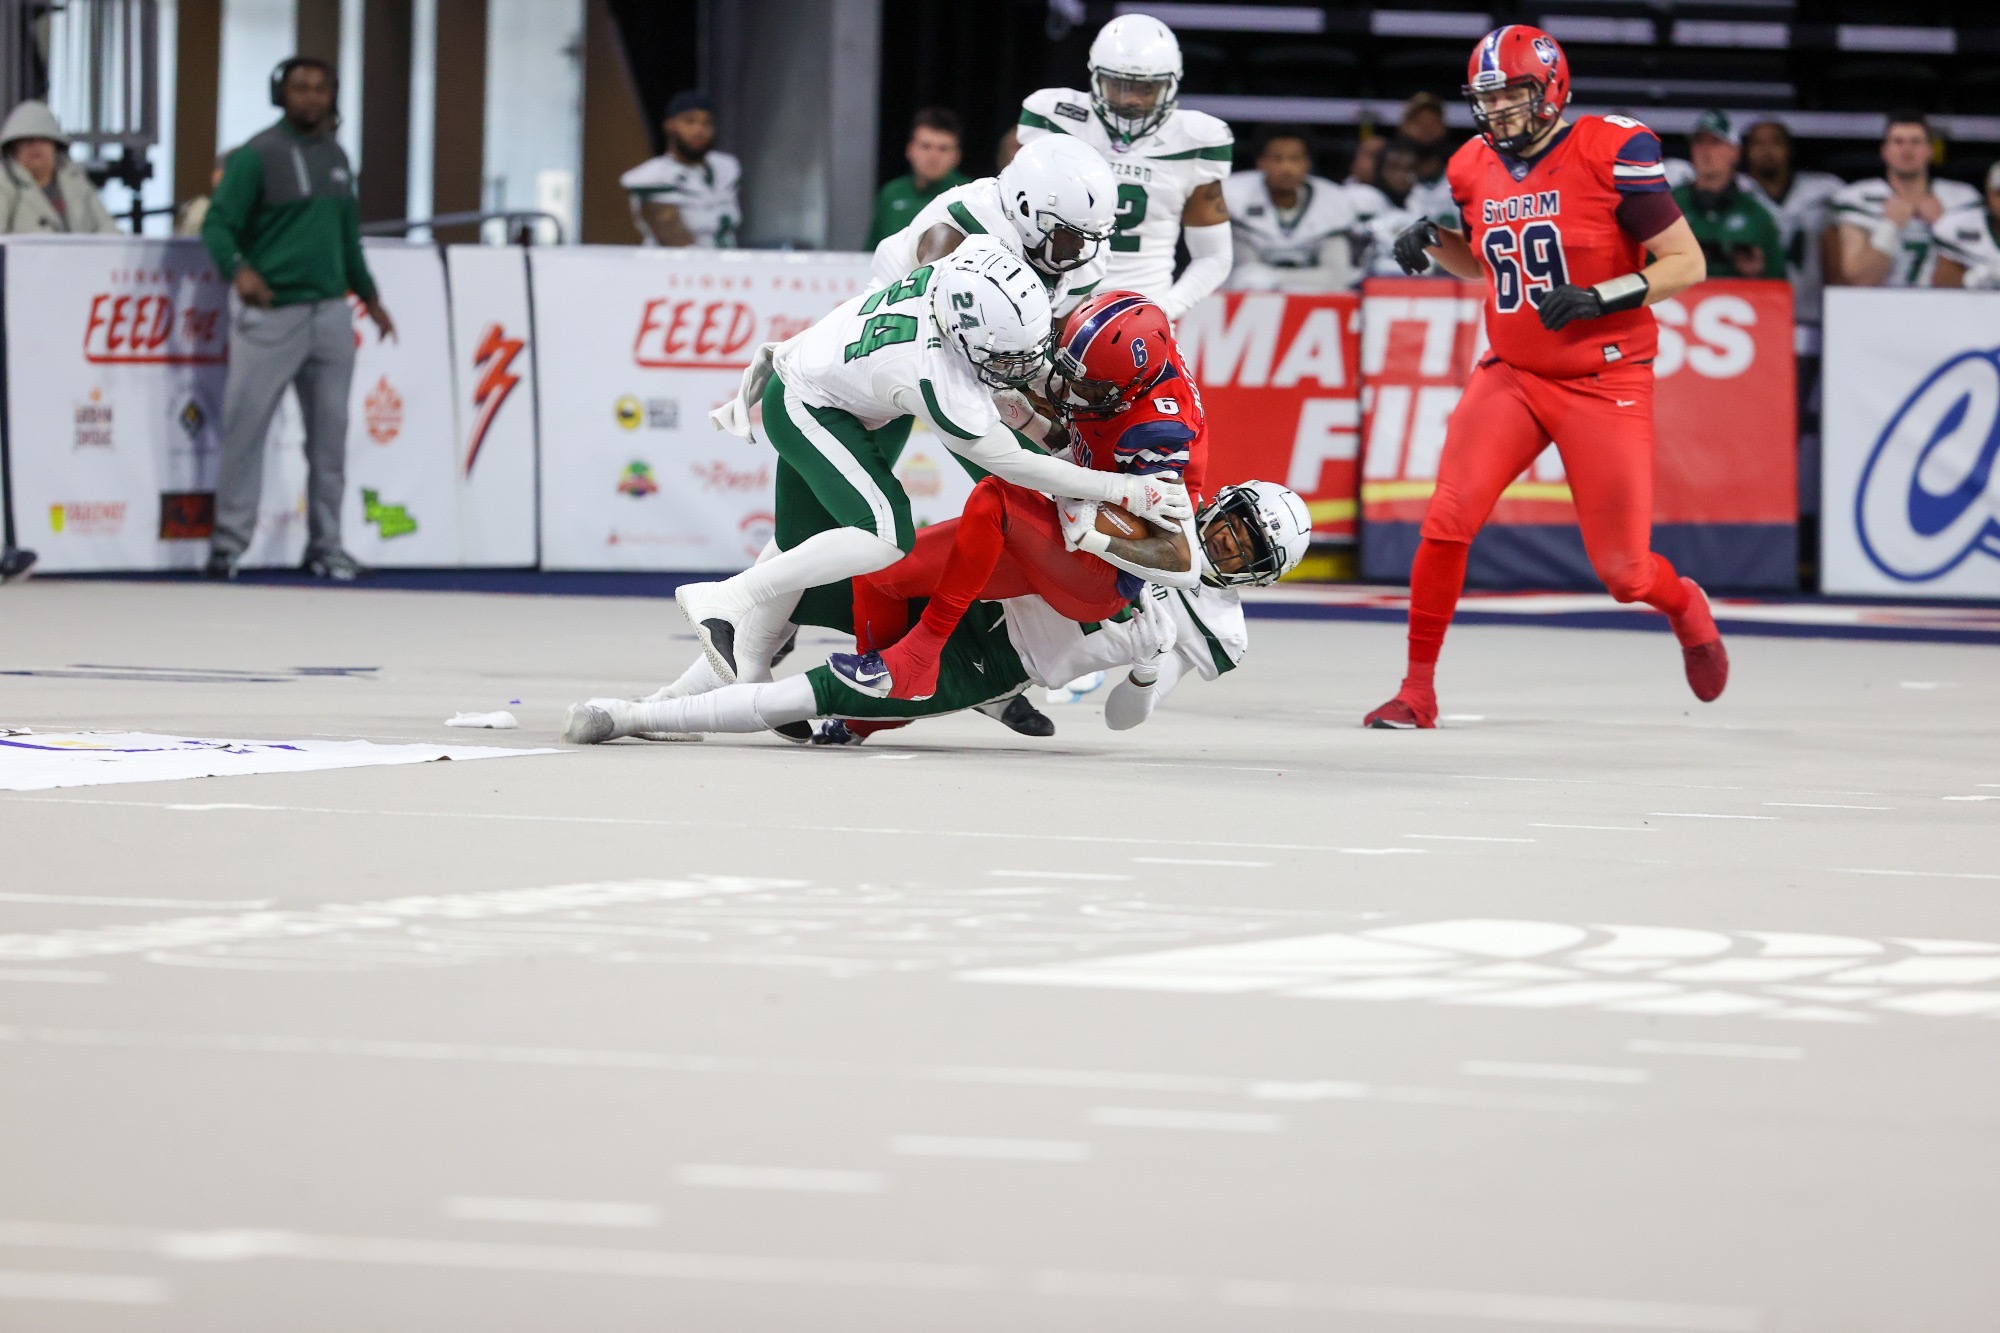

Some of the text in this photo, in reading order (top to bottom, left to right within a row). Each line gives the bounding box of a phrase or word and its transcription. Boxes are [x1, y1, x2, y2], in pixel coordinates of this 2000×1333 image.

[1532, 36, 1560, 65] 69
[1483, 190, 1560, 223] STORM
[1482, 220, 1570, 314] 69
[84, 294, 175, 350] FEED
[633, 297, 756, 356] FEED
[844, 264, 935, 364] 24
[951, 291, 981, 330] 24
[1131, 338, 1148, 369] 6
[1153, 397, 1180, 415] 6
